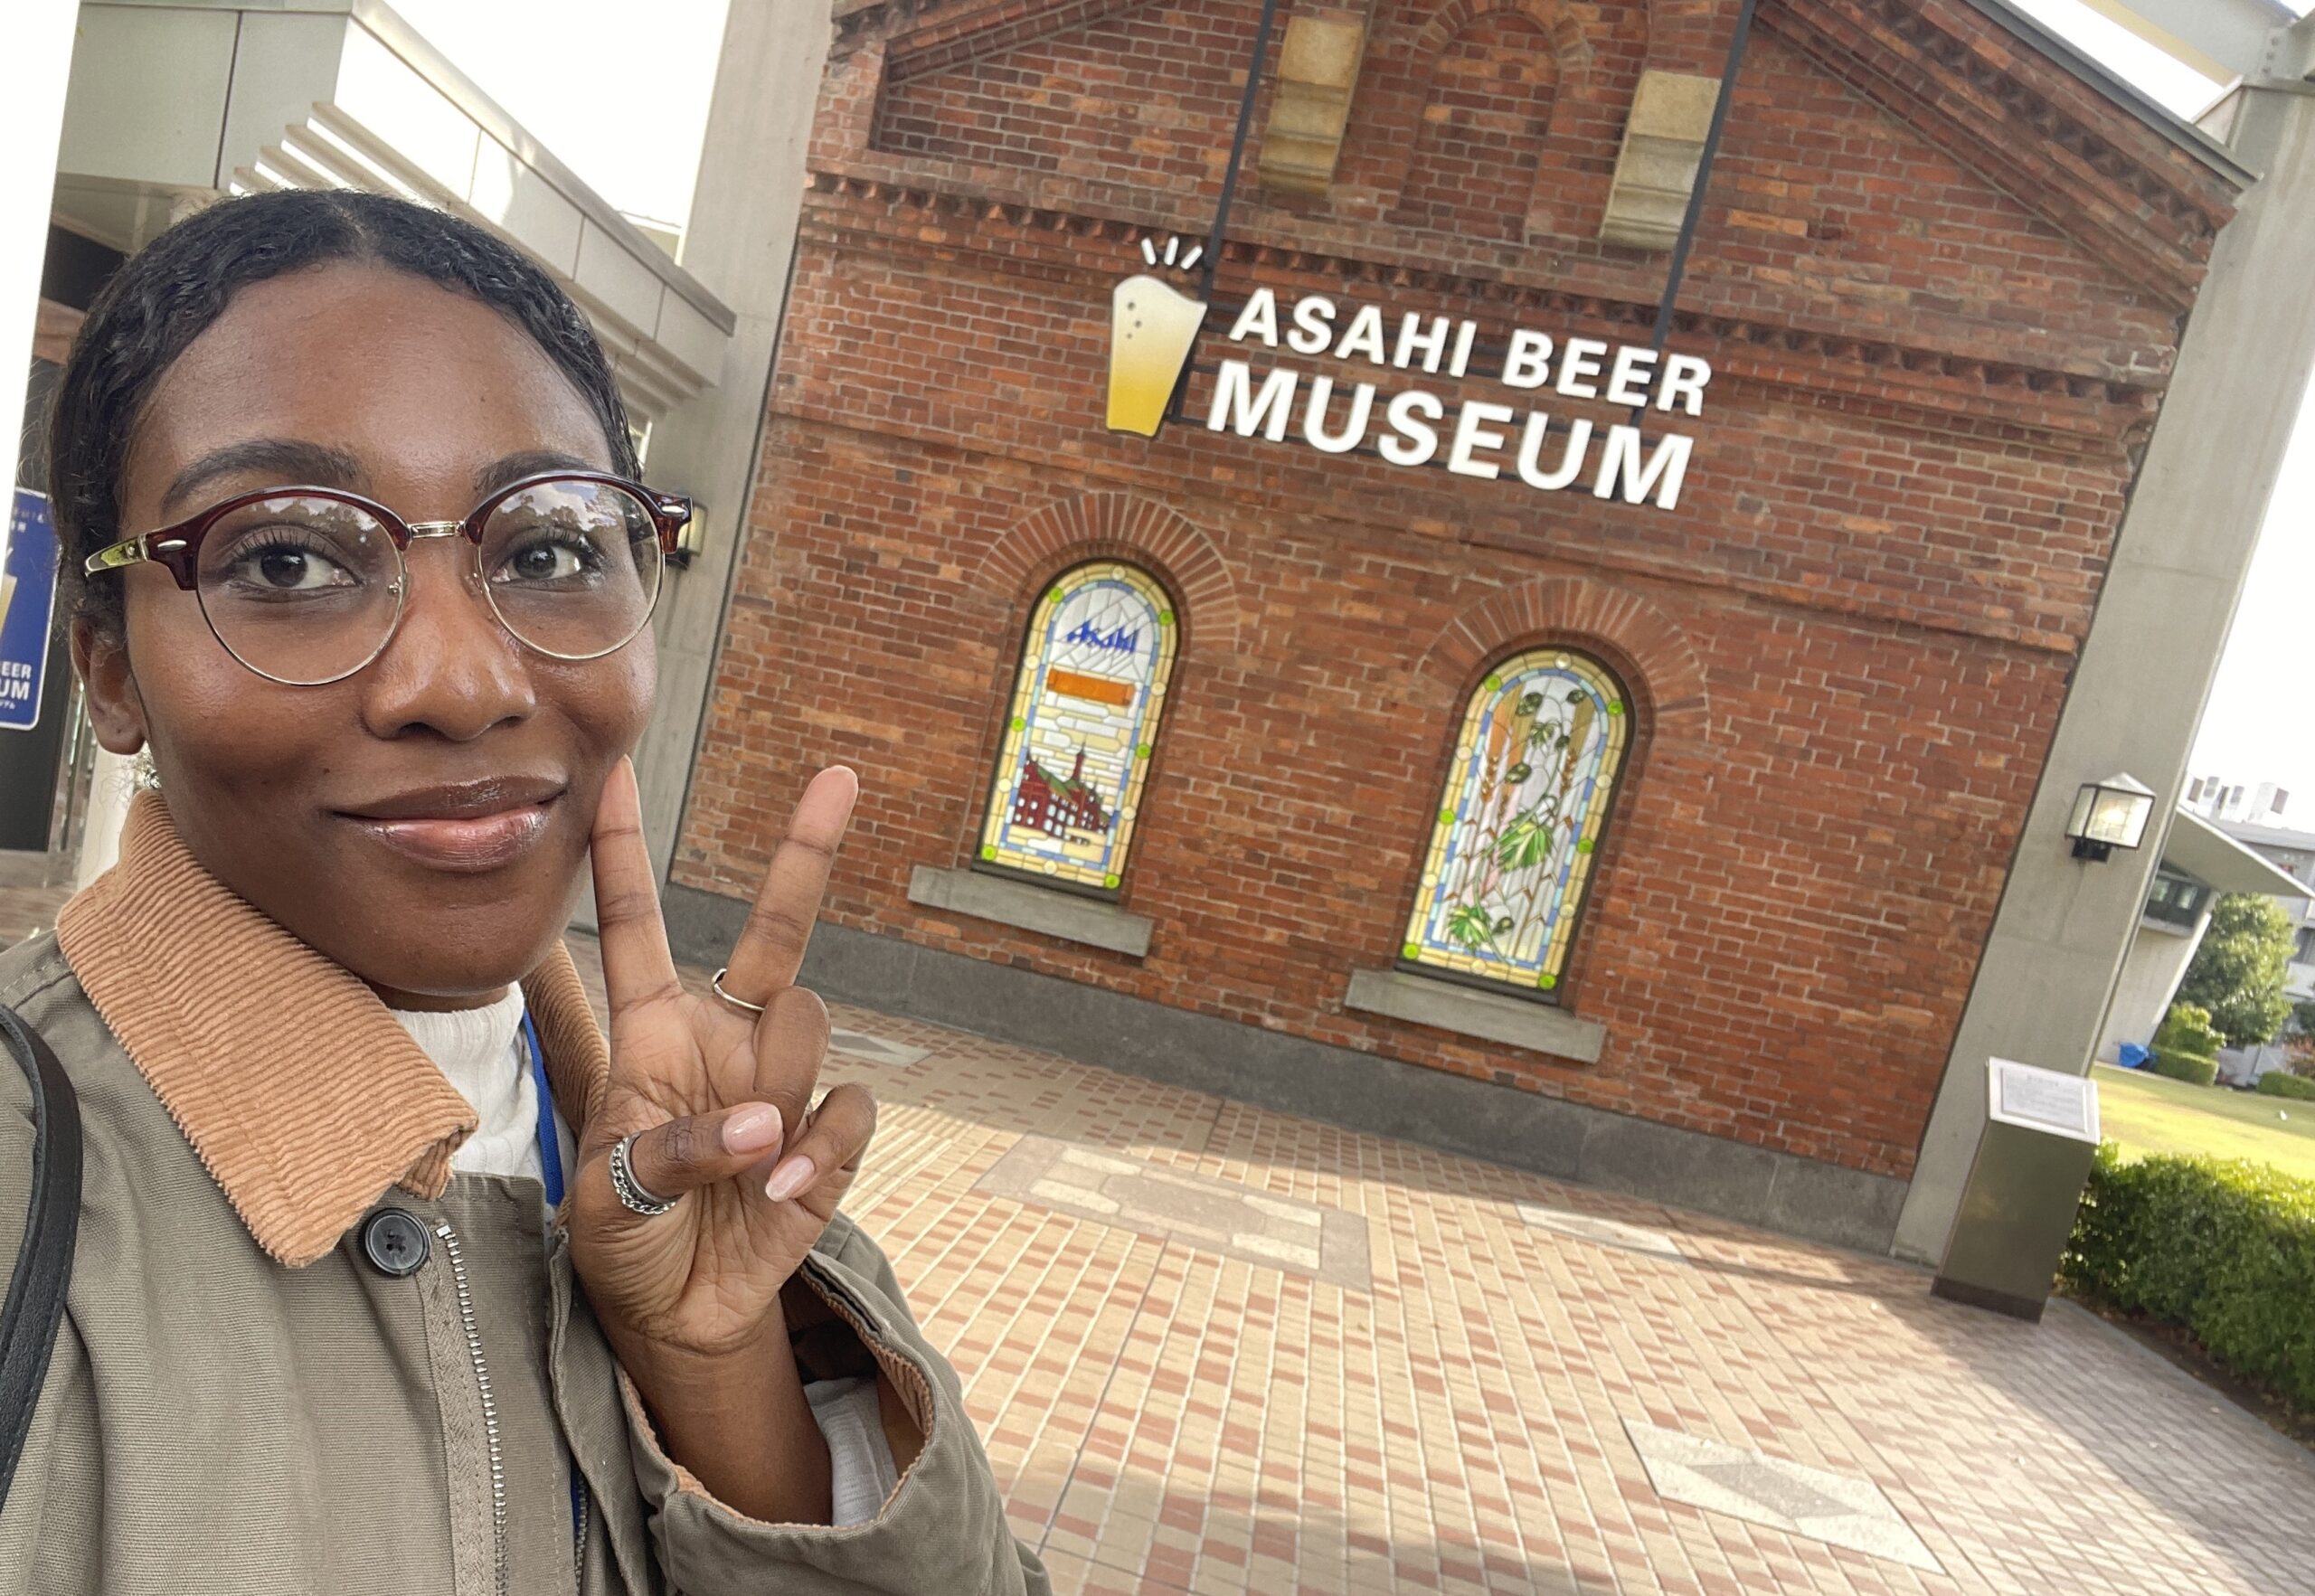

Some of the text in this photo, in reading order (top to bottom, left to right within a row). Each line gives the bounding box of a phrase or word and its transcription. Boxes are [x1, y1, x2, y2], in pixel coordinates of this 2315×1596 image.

[1228, 288, 1712, 416] ASAHI BEER
[1206, 360, 1695, 511] MUSEUM
